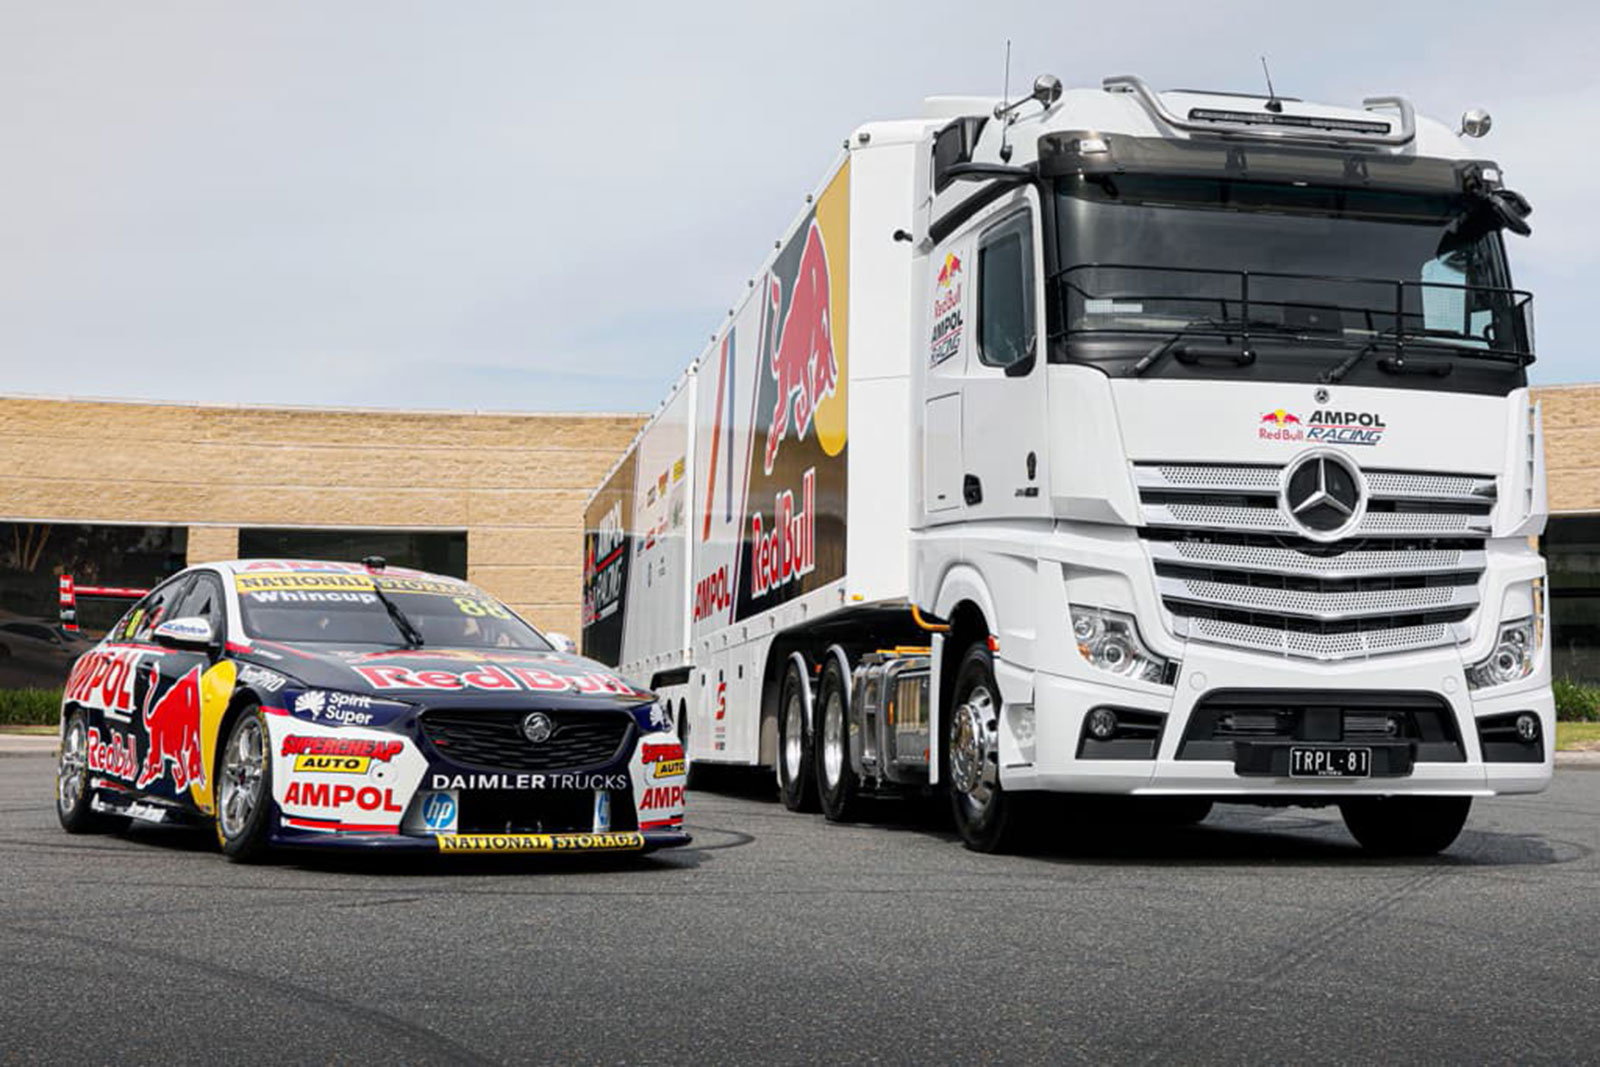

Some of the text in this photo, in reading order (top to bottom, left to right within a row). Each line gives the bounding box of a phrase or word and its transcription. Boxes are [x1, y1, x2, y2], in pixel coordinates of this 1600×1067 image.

[931, 309, 963, 342] AMPOL
[1309, 410, 1386, 427] AMPOL
[1307, 427, 1382, 442] RACING
[241, 576, 370, 588] NATIONAL
[250, 591, 376, 603] Whincup
[694, 564, 730, 623] AMPOL
[328, 691, 372, 708] Spirit
[325, 705, 374, 725] Super
[281, 733, 404, 763] SUPERCHEAP
[303, 758, 360, 769] AUTO
[432, 774, 627, 790] DAIMLER TRUCKS
[283, 781, 403, 812] AMPOL
[426, 794, 455, 829] hp
[443, 834, 638, 849] NATIONAL STORAGE
